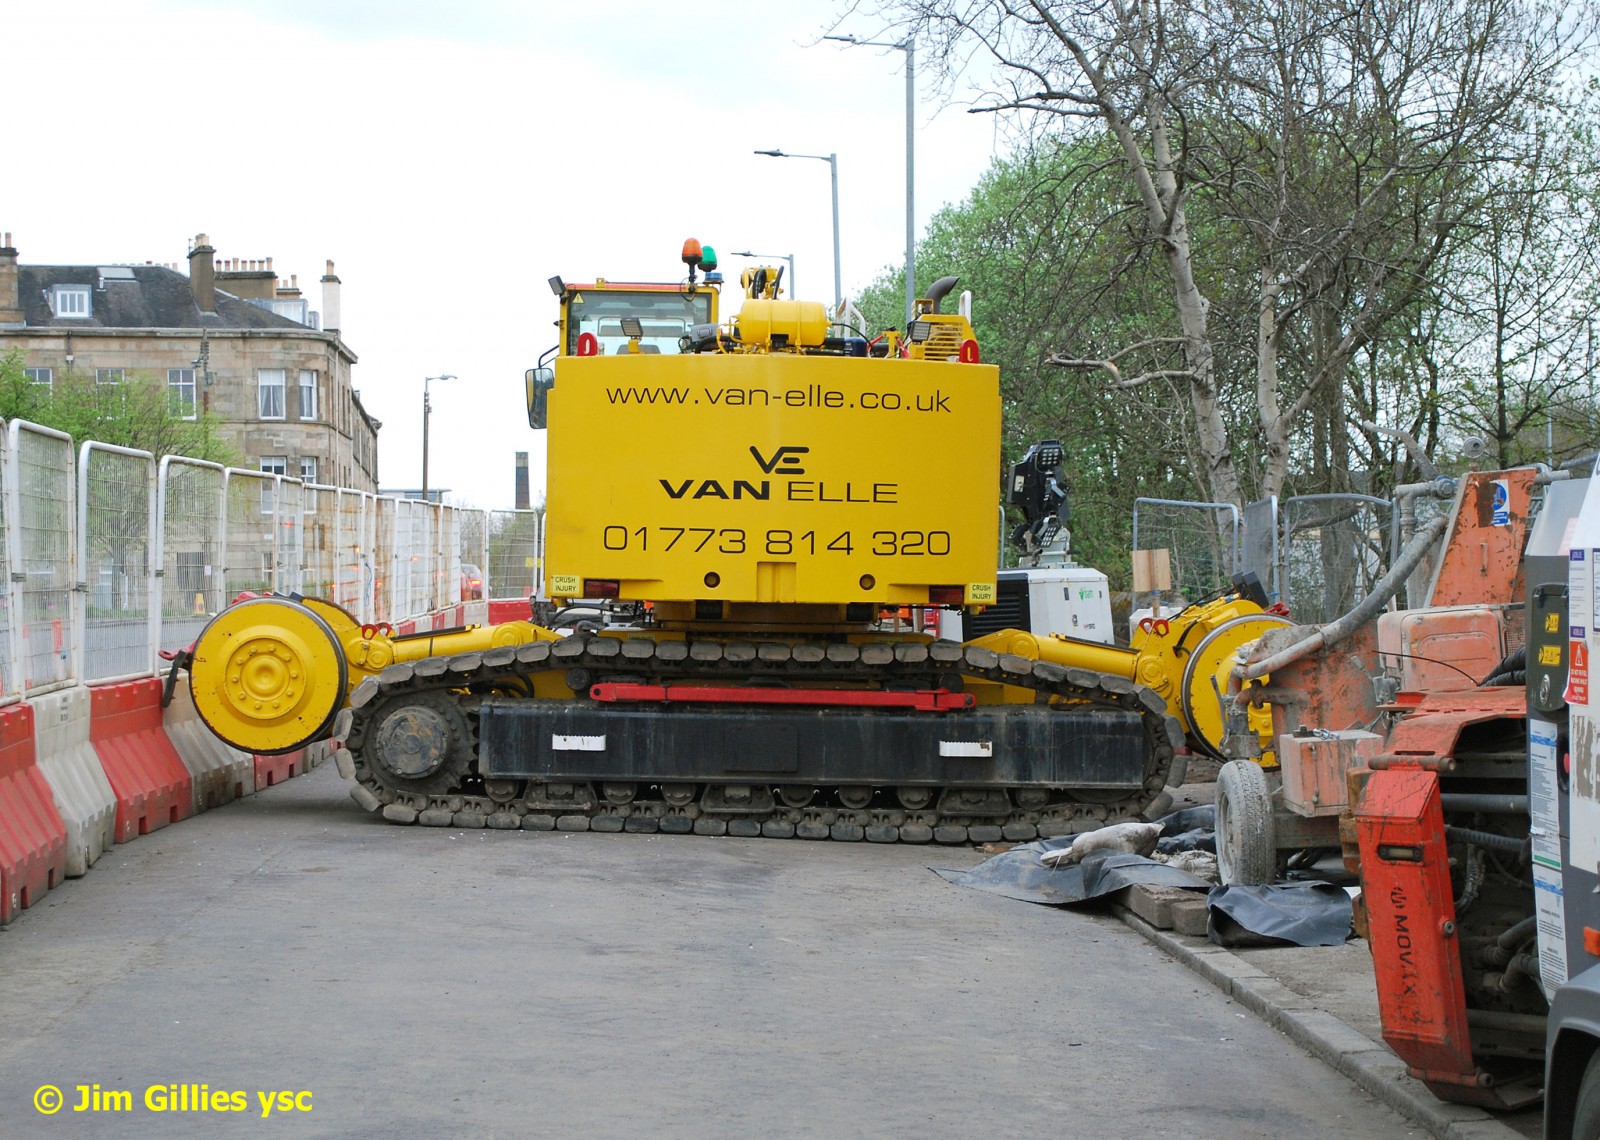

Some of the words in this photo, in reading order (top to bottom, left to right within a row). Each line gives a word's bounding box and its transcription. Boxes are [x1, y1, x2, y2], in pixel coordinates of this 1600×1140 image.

[606, 384, 952, 413] www.van-elle.co.uk
[658, 479, 770, 501] VAN
[787, 481, 898, 504] ELLE
[603, 525, 746, 554] 01773
[765, 529, 855, 556] 814
[872, 530, 951, 556] 320
[555, 576, 576, 584] CRUSH
[972, 584, 991, 592] CRUSH
